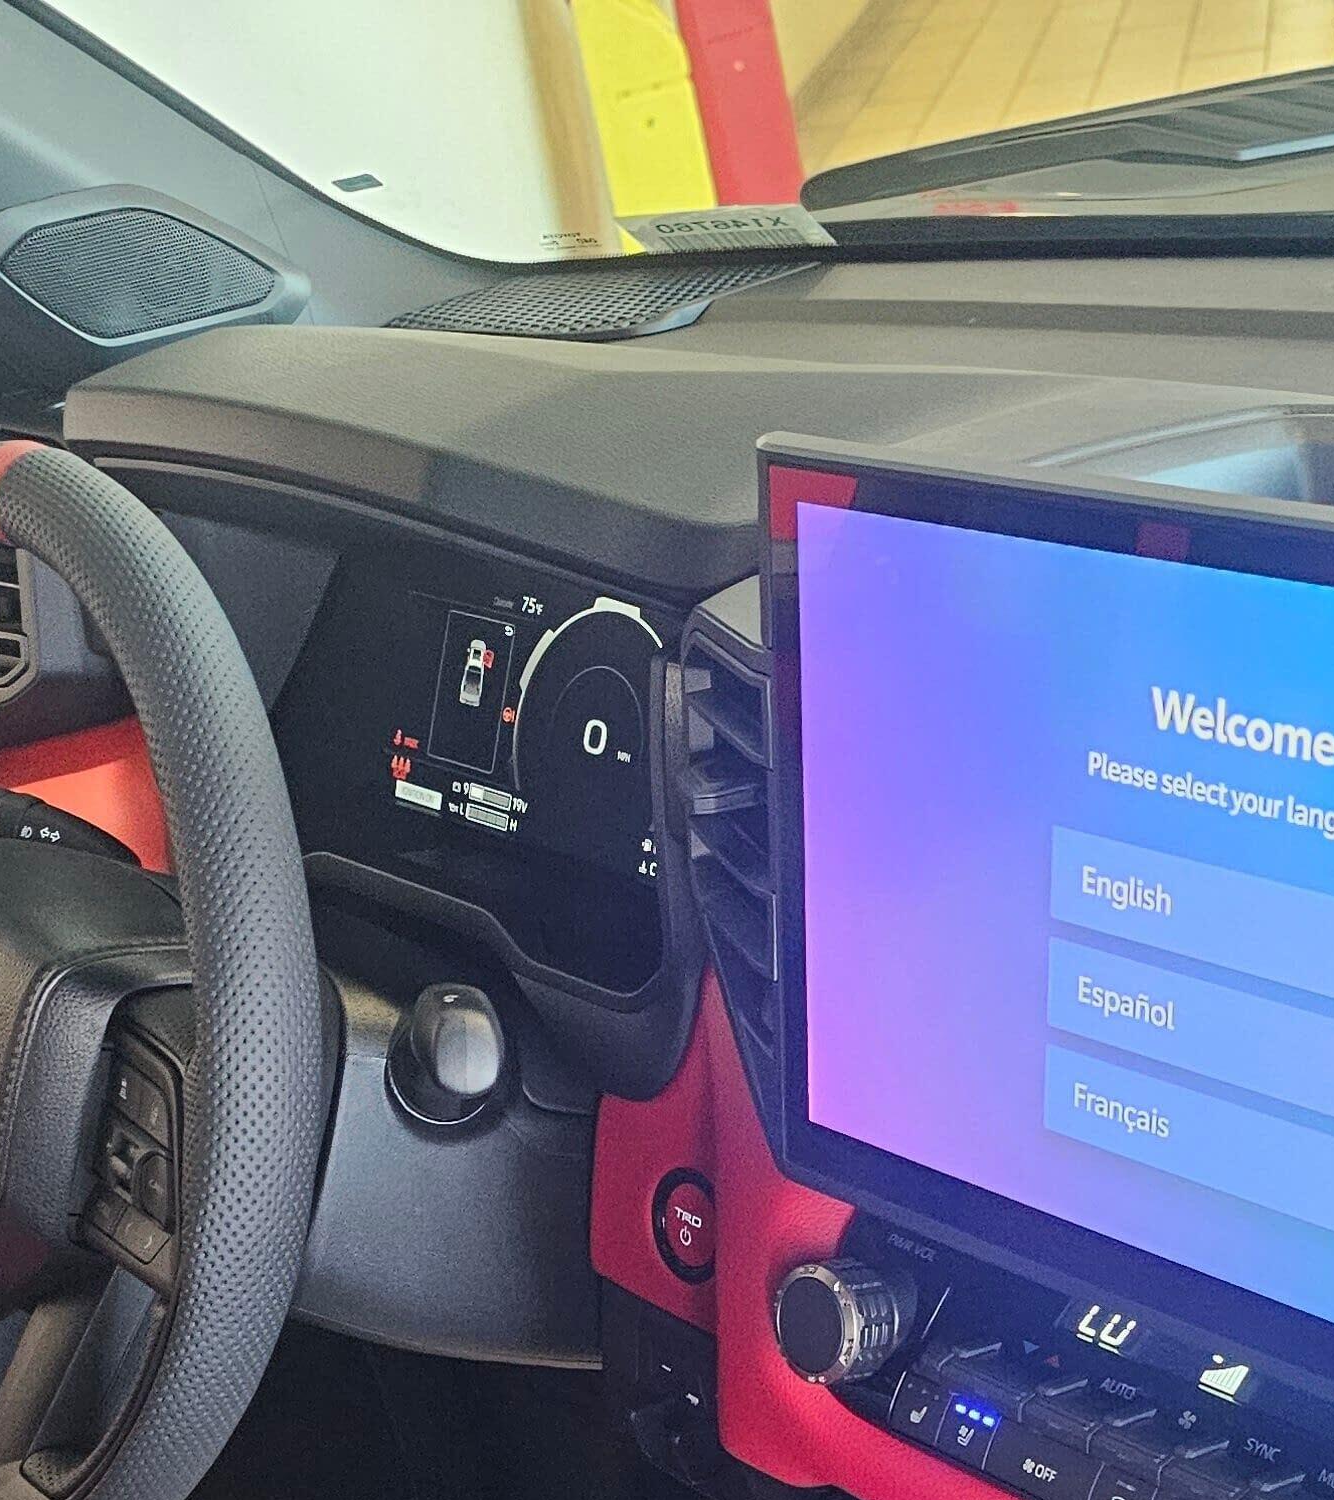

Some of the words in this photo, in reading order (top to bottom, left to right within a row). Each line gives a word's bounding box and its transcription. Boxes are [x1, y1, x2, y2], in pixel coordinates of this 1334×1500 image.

[583, 719, 608, 755] 0
[1088, 751, 1157, 793] Please
[1162, 771, 1228, 808] select
[1229, 788, 1284, 818] your
[1082, 865, 1173, 916] English
[1077, 976, 1175, 1031] Español
[1073, 1082, 1170, 1139] Français
[674, 1206, 702, 1229] TRD
[1100, 1377, 1137, 1400] AUTO
[1243, 1438, 1281, 1463] SYNC
[1034, 1463, 1057, 1483] OFF
